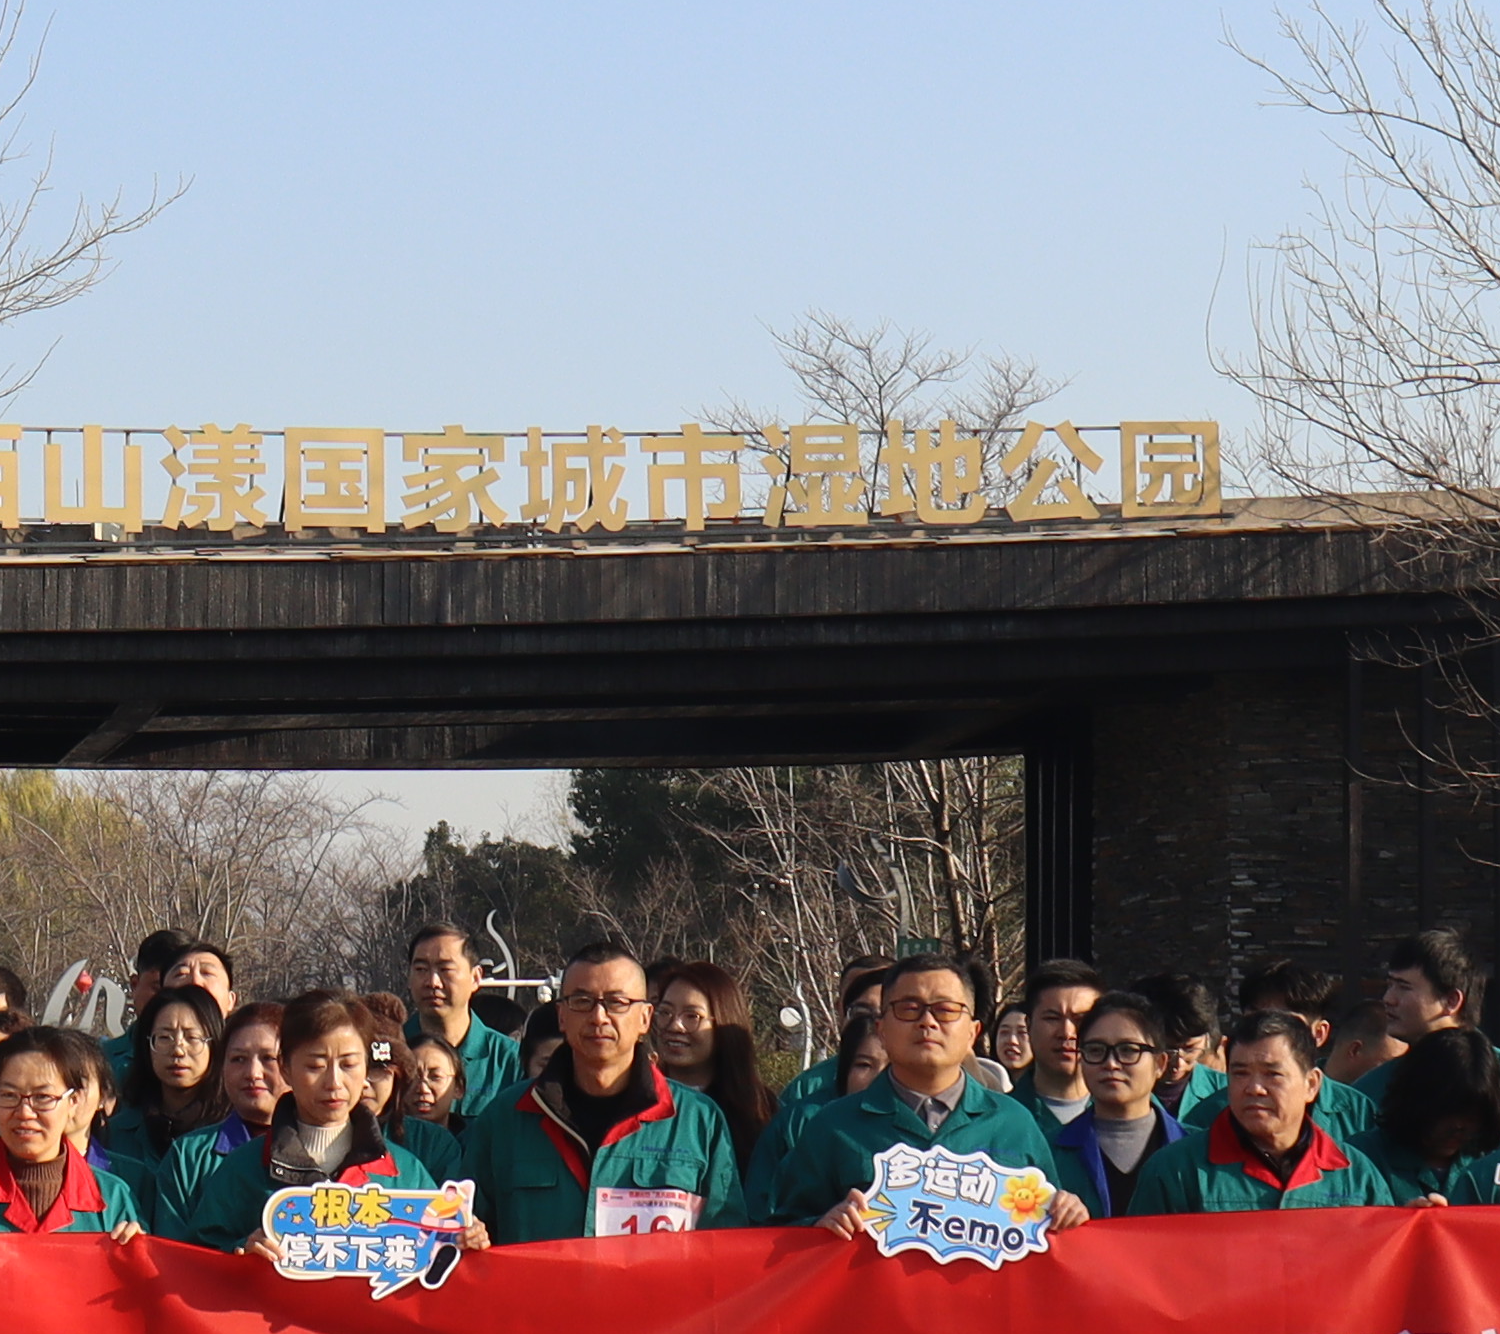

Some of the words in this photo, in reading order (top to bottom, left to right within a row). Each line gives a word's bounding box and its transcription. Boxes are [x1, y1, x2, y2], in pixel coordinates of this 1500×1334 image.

[886, 1150, 998, 1208] 多运动
[310, 1188, 393, 1229] 根本
[908, 1199, 1025, 1252] 不emo
[279, 1233, 417, 1270] 停不下来
